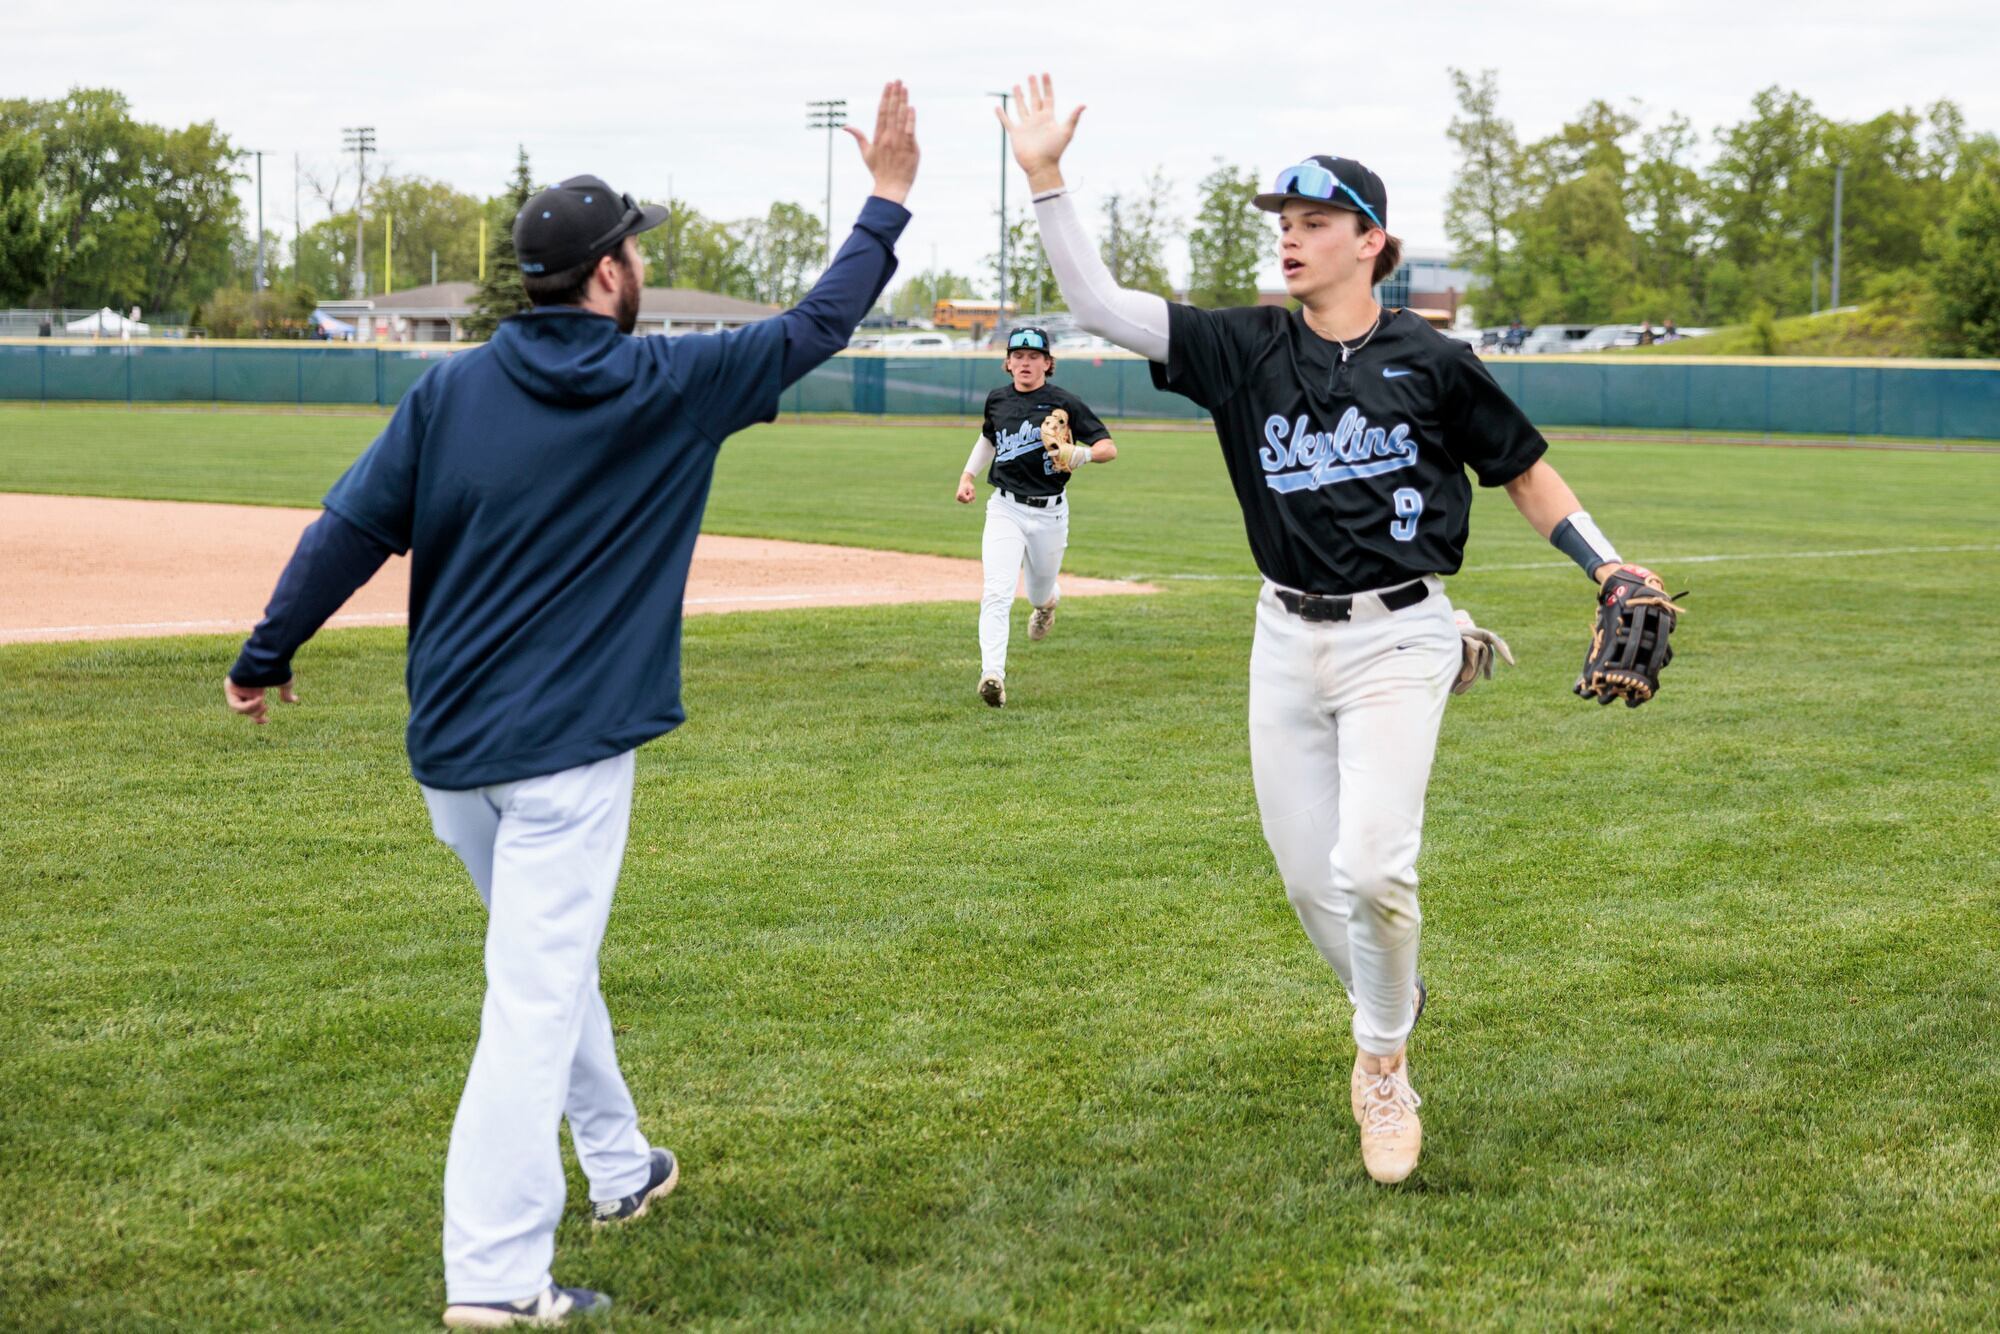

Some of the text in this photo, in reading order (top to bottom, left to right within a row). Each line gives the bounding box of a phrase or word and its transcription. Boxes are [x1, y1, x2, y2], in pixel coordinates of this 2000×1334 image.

[995, 420, 1042, 460] Skylin
[1259, 406, 1418, 491] Skyline
[1390, 487, 1423, 541] 9
